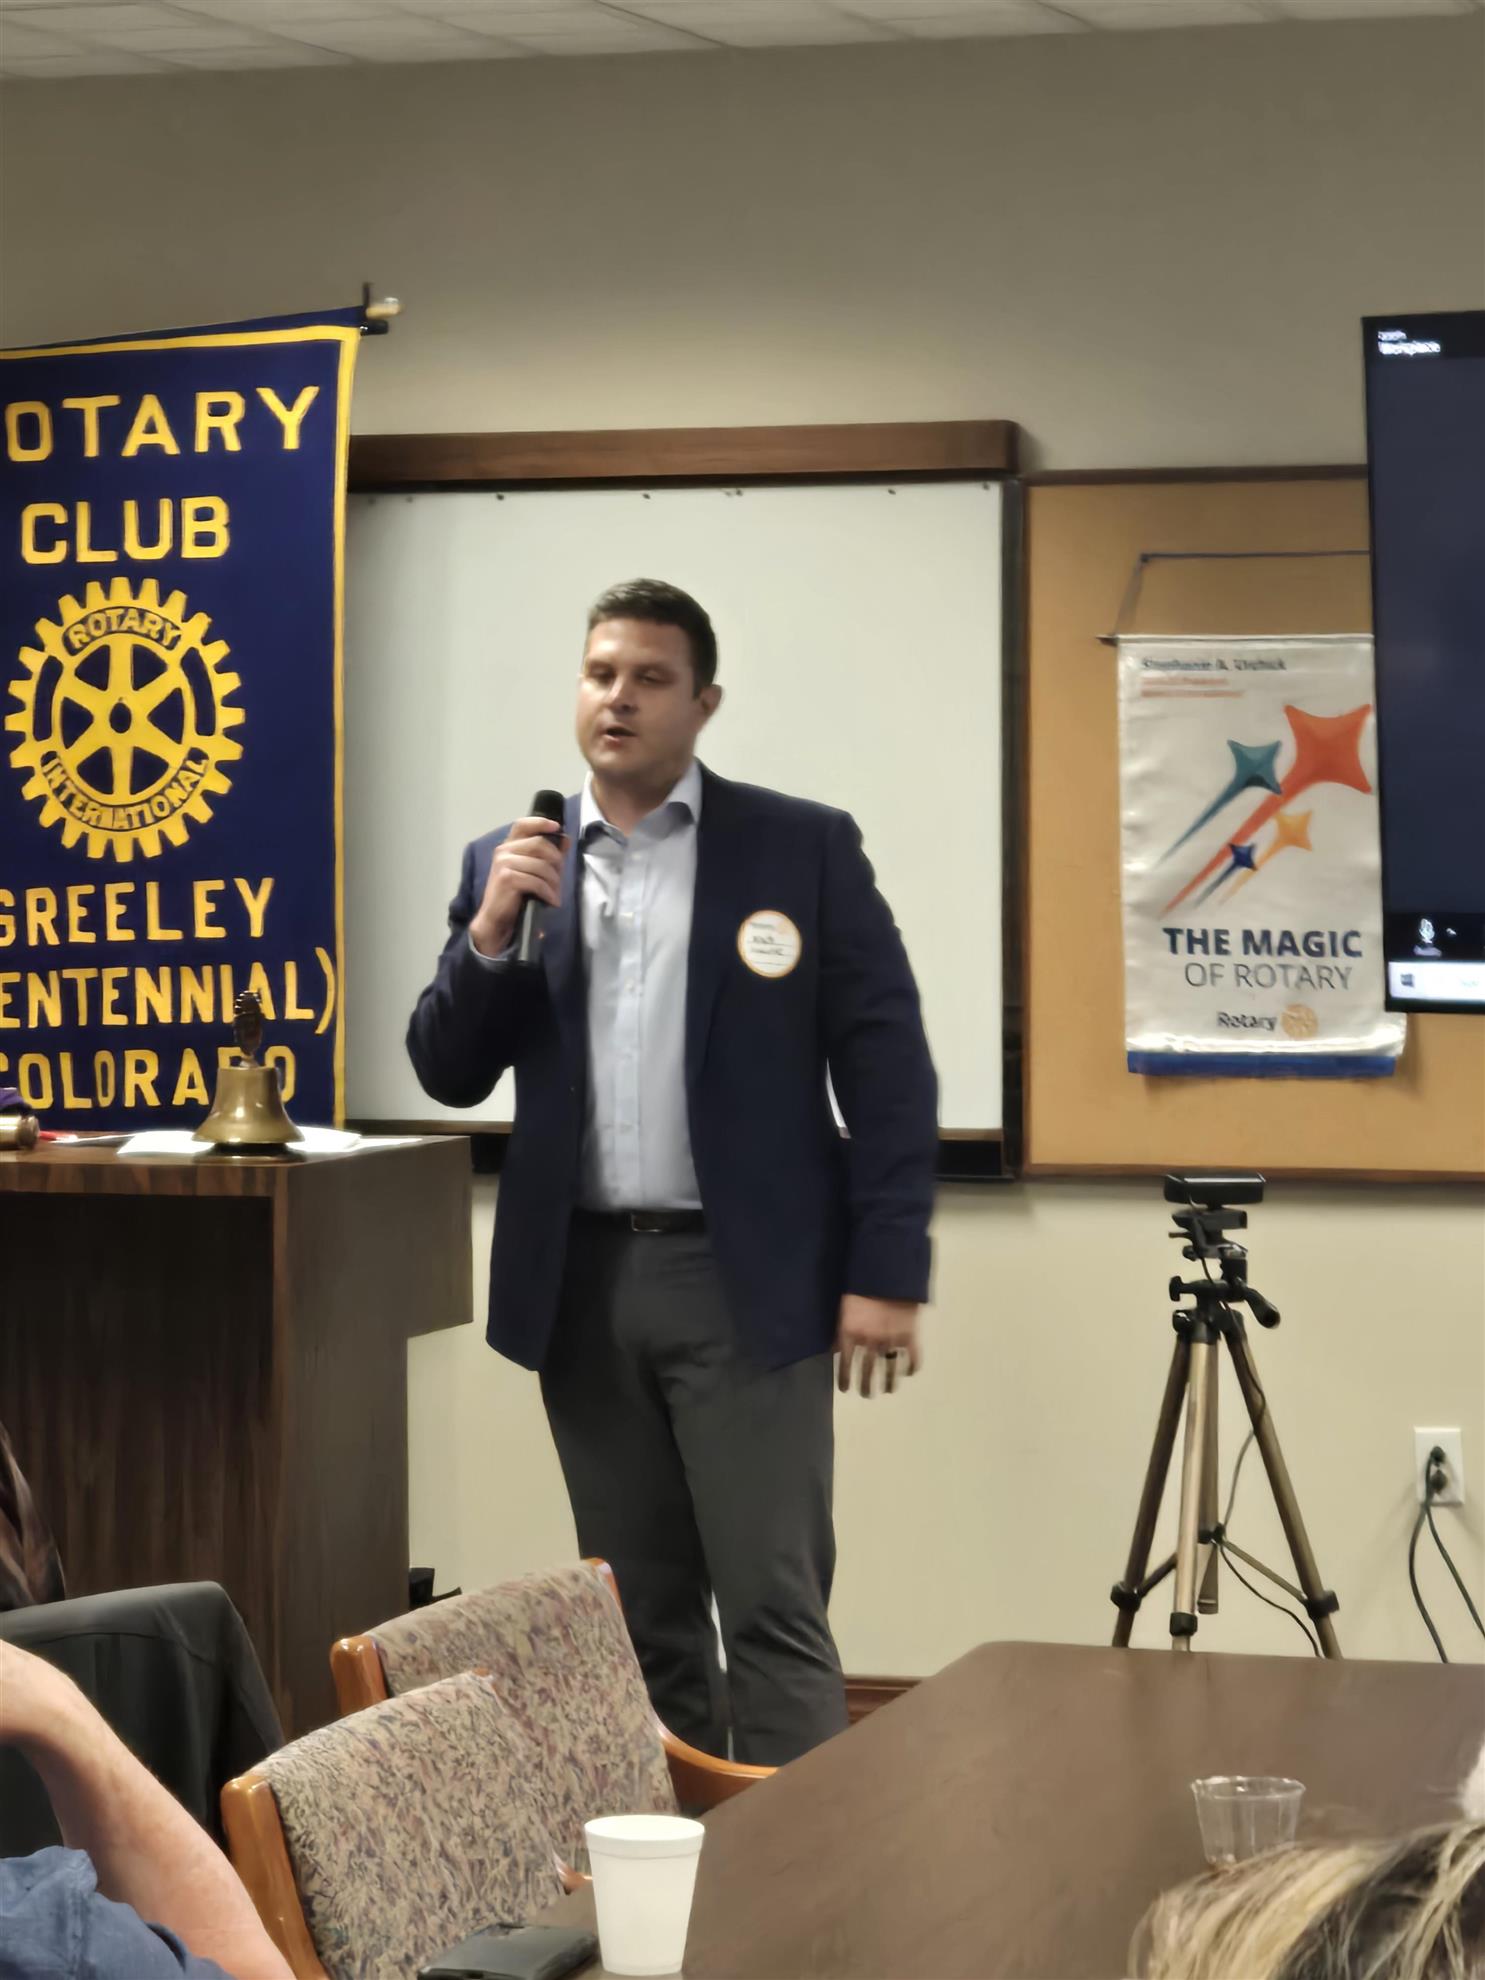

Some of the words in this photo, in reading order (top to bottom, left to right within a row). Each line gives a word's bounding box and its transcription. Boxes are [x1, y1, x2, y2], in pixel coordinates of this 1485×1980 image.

[4, 385, 320, 462] OTARY
[20, 496, 231, 565] CLUB
[68, 607, 183, 650] ROTARY
[42, 756, 209, 830] INTERNATIONAL
[0, 877, 275, 948] GREELEY
[1162, 927, 1232, 956] THE
[1242, 928, 1363, 959] MAGIC
[1184, 962, 1225, 988] OF
[1233, 962, 1353, 991] ROTARY
